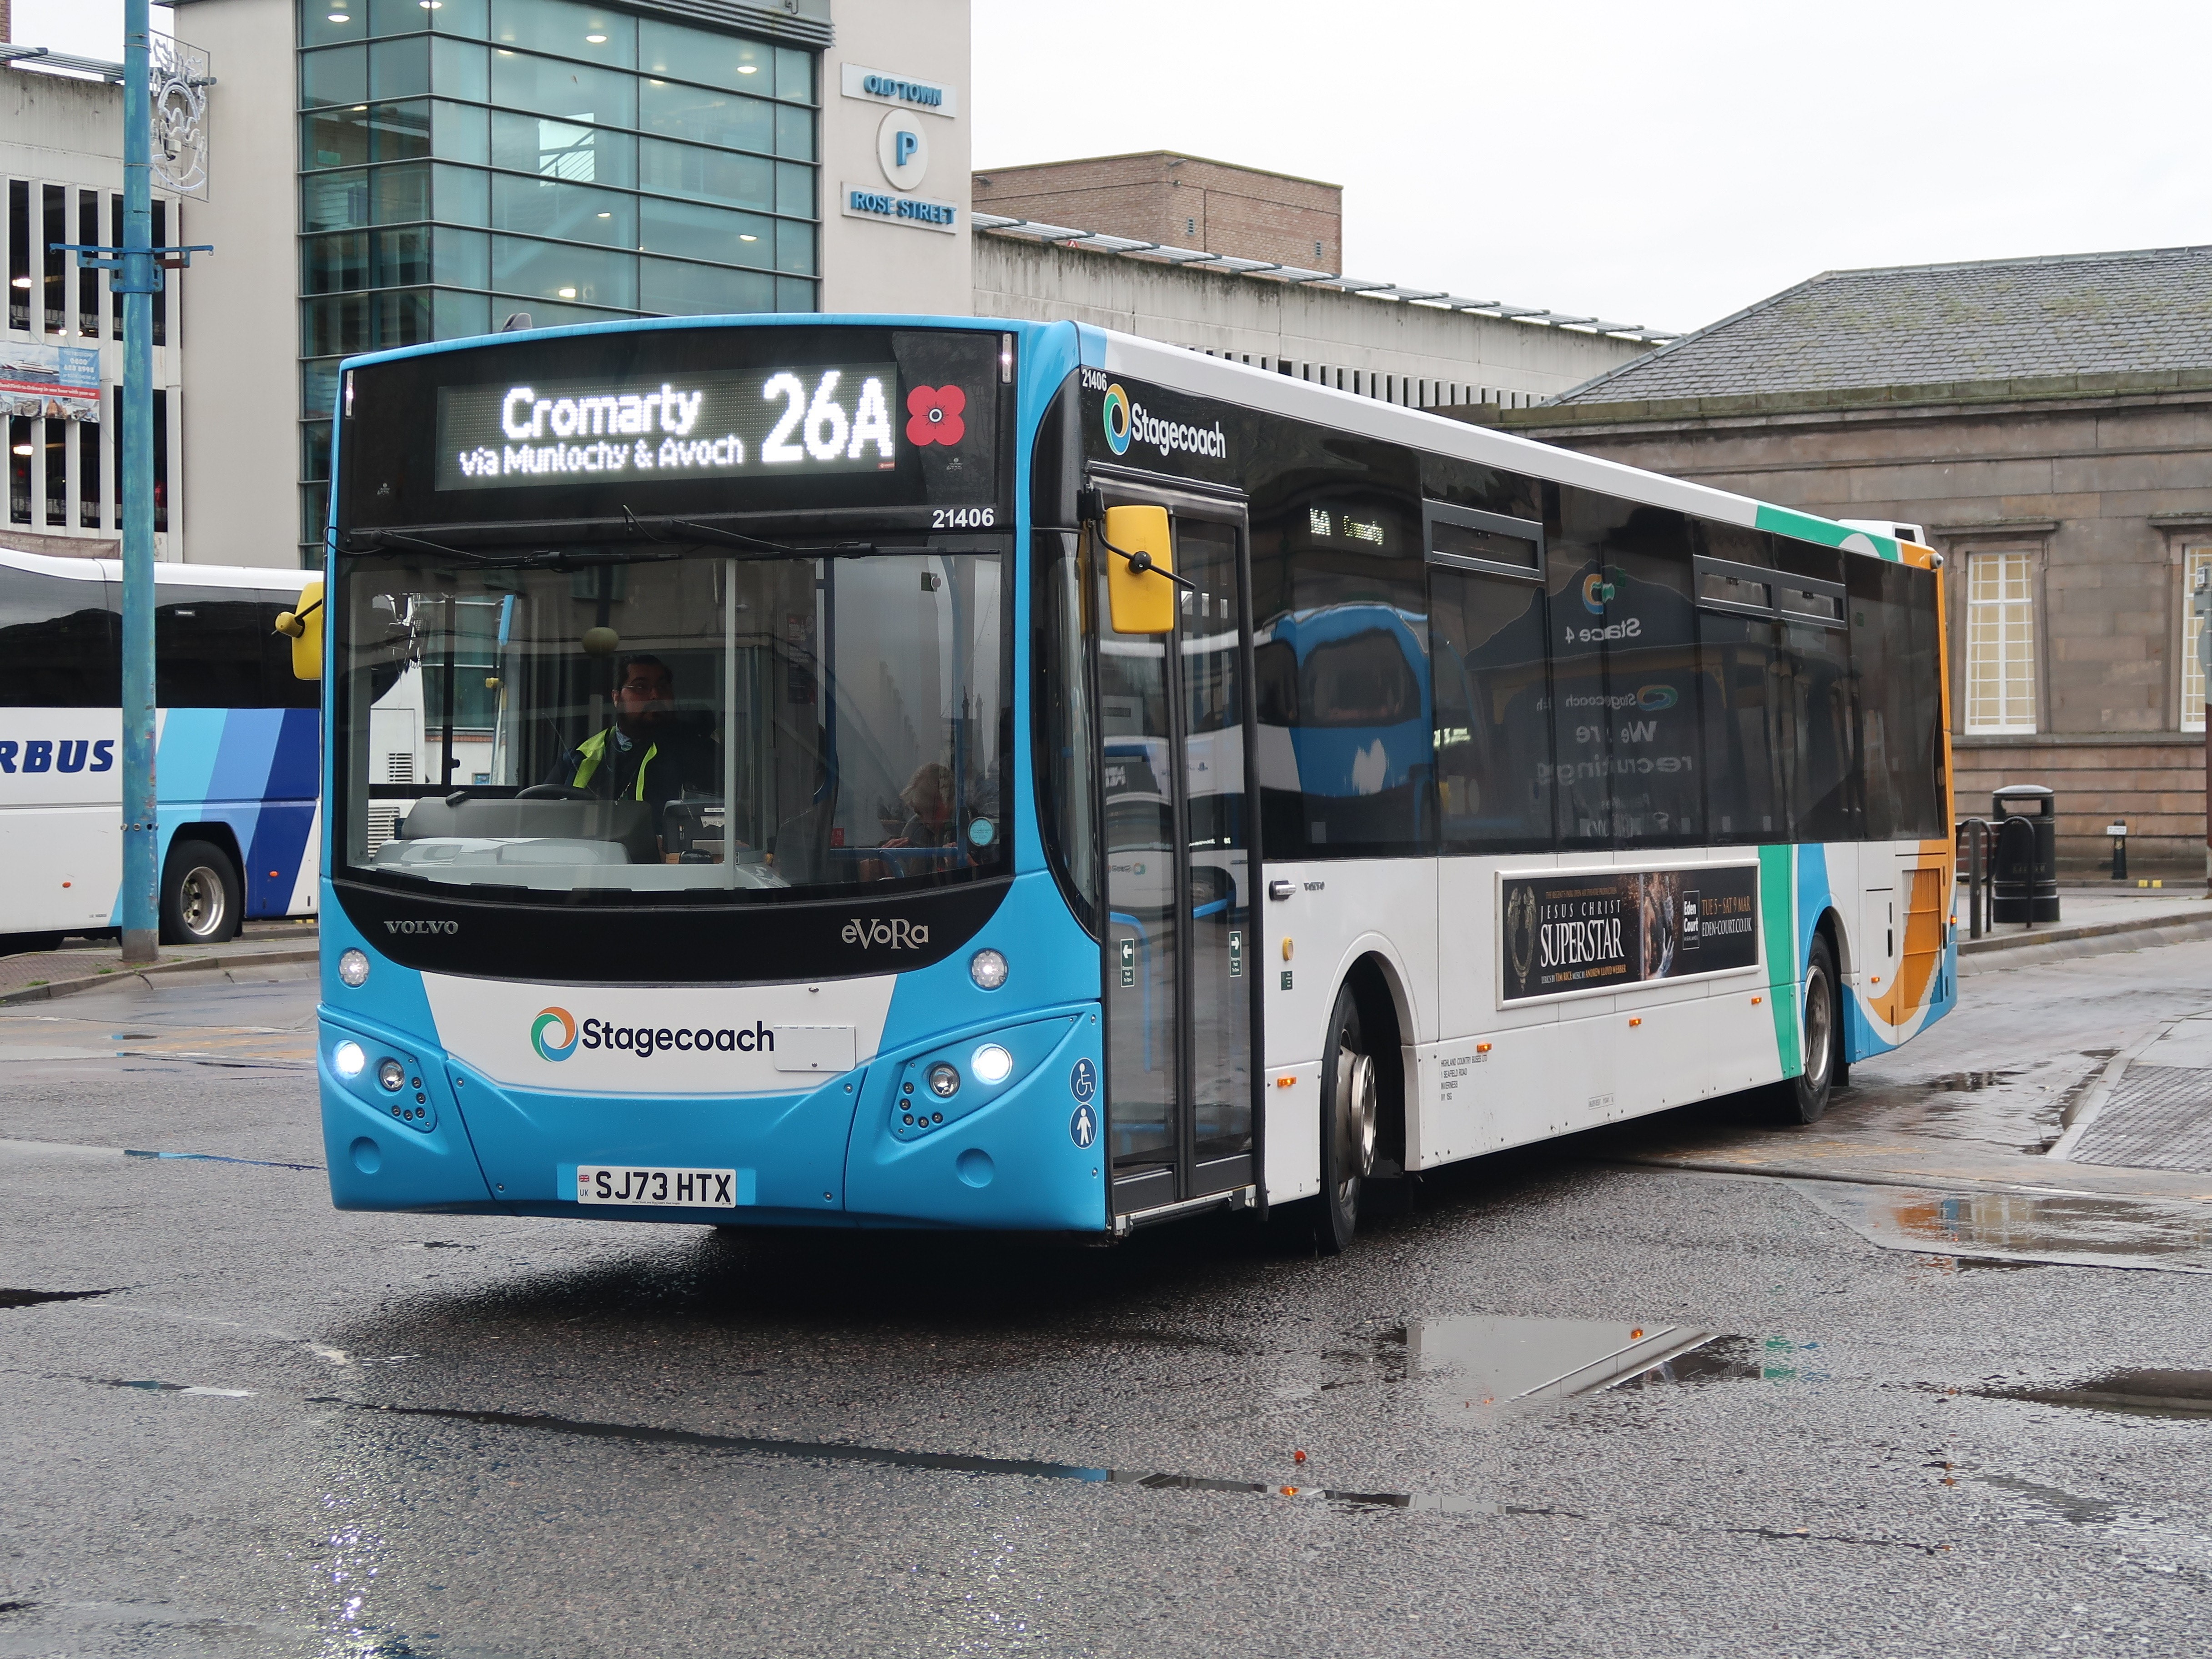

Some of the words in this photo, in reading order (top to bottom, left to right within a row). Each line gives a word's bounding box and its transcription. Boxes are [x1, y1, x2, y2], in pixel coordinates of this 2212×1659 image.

[864, 75, 896, 96] OLD
[897, 80, 942, 106] TOWN
[896, 131, 918, 166] P
[850, 191, 896, 215] ROSE
[897, 199, 957, 225] STREET
[1081, 368, 1108, 392] 21406
[501, 383, 702, 439] Cromarty
[761, 371, 893, 463] 26A
[1131, 402, 1226, 459] Stagecoach
[459, 446, 499, 476] via
[503, 441, 629, 474] Munlochy
[634, 439, 653, 468] &
[658, 434, 744, 467] Avoch
[931, 508, 995, 528] 21406
[1540, 903, 1574, 924] JESUS
[1581, 899, 1621, 916] CHRIST
[1684, 900, 1697, 915] Eden
[1702, 898, 1713, 916] TUE
[1714, 899, 1718, 915] 5
[1722, 897, 1733, 914] SAT
[1733, 896, 1737, 913] 9
[1738, 895, 1751, 912] MAR
[383, 920, 459, 935] VOLVO
[1684, 917, 1699, 933] Court
[1702, 917, 1753, 937] EDEN-COURT.CO.UK
[1540, 918, 1625, 968] SUPERSTAR
[582, 1018, 774, 1058] Stagecoach
[579, 1189, 589, 1197] UK
[596, 1171, 668, 1201] SJ73
[677, 1173, 731, 1203] HTX
